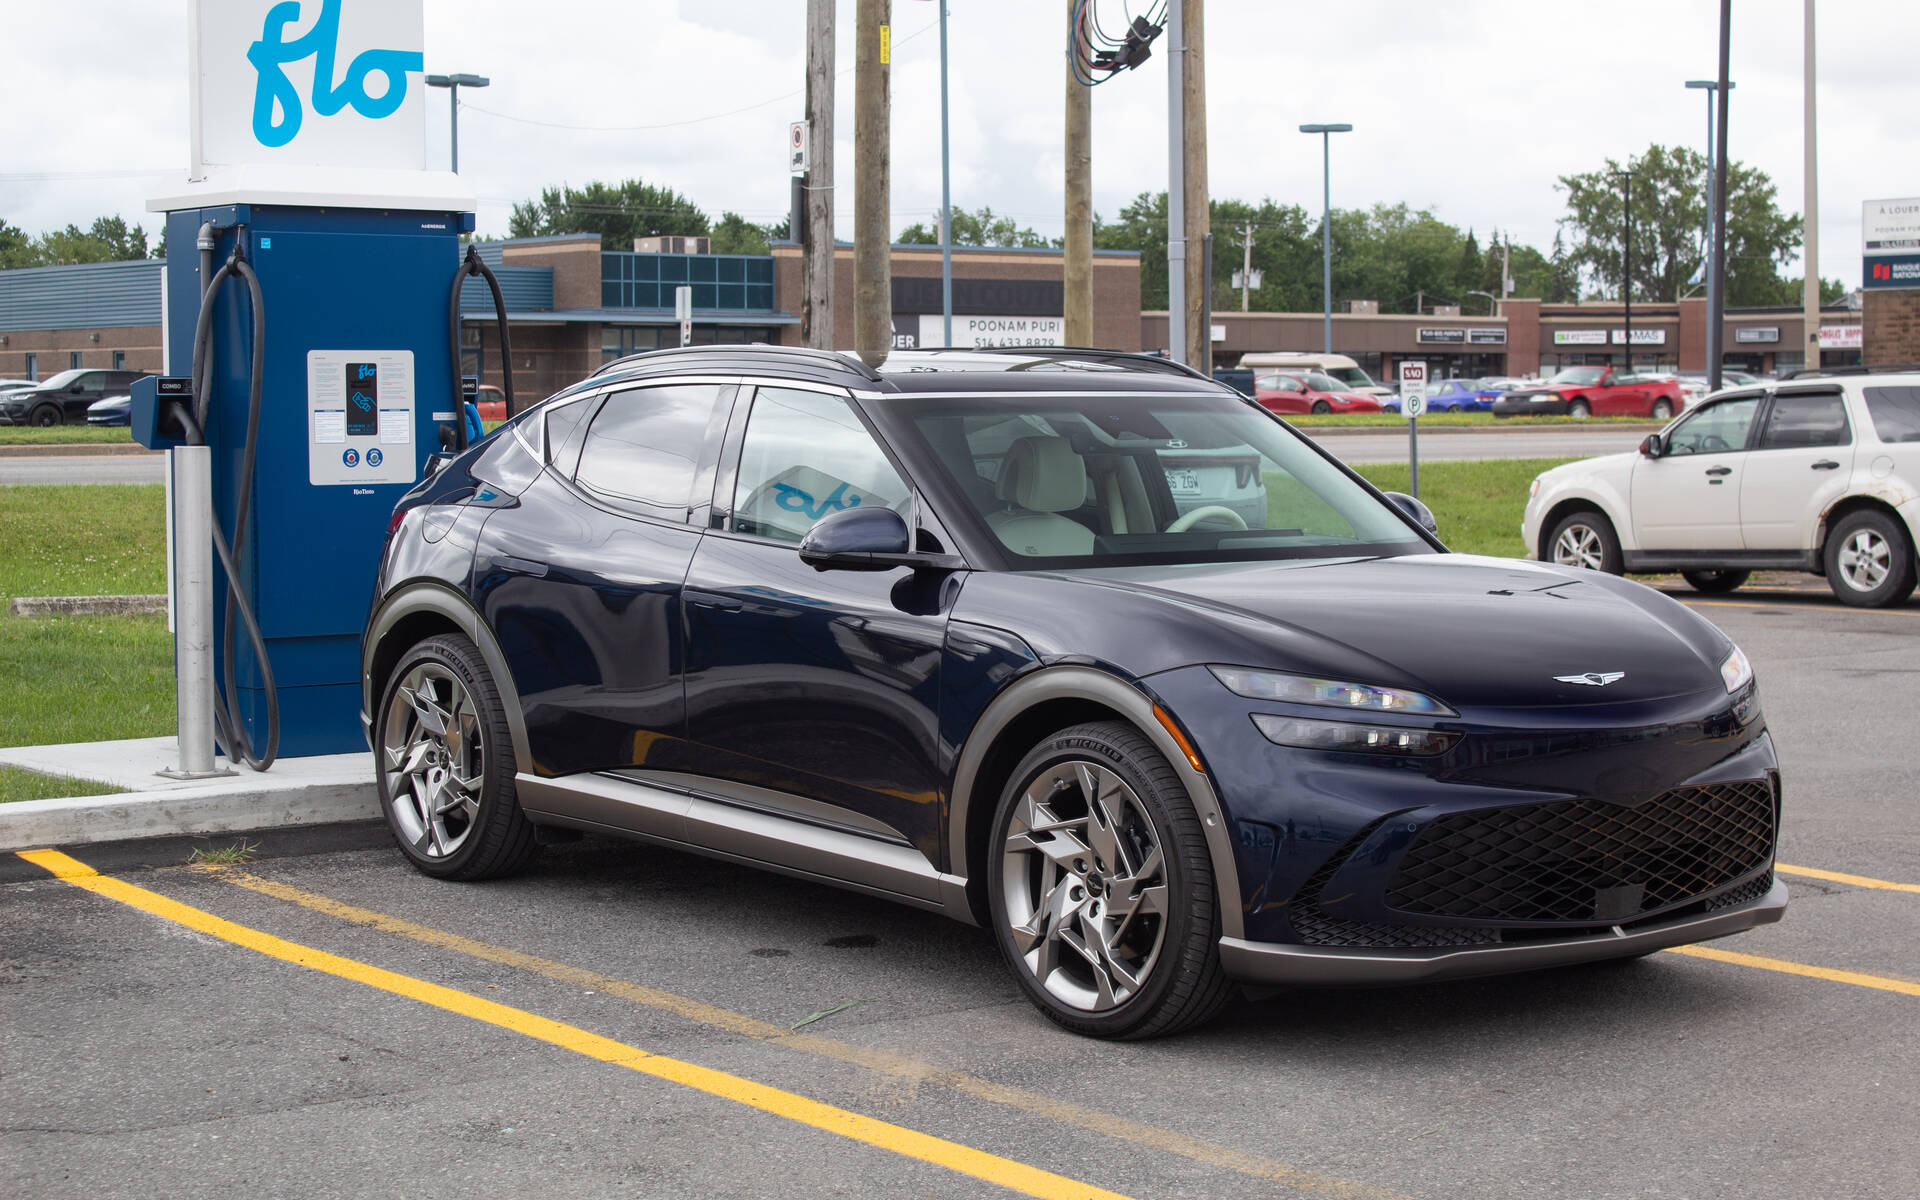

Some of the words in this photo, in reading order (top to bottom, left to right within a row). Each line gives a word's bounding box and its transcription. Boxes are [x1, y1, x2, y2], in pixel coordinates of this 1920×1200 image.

[246, 0, 424, 148] flo
[969, 320, 1027, 333] POONAM
[1032, 321, 1060, 333] PURI
[975, 338, 994, 348] 514
[1000, 338, 1020, 348] 433
[1026, 338, 1055, 347] 8879
[358, 363, 376, 379] flo
[1180, 475, 1199, 489] ZGW
[1070, 739, 1120, 761] MICHELIN
